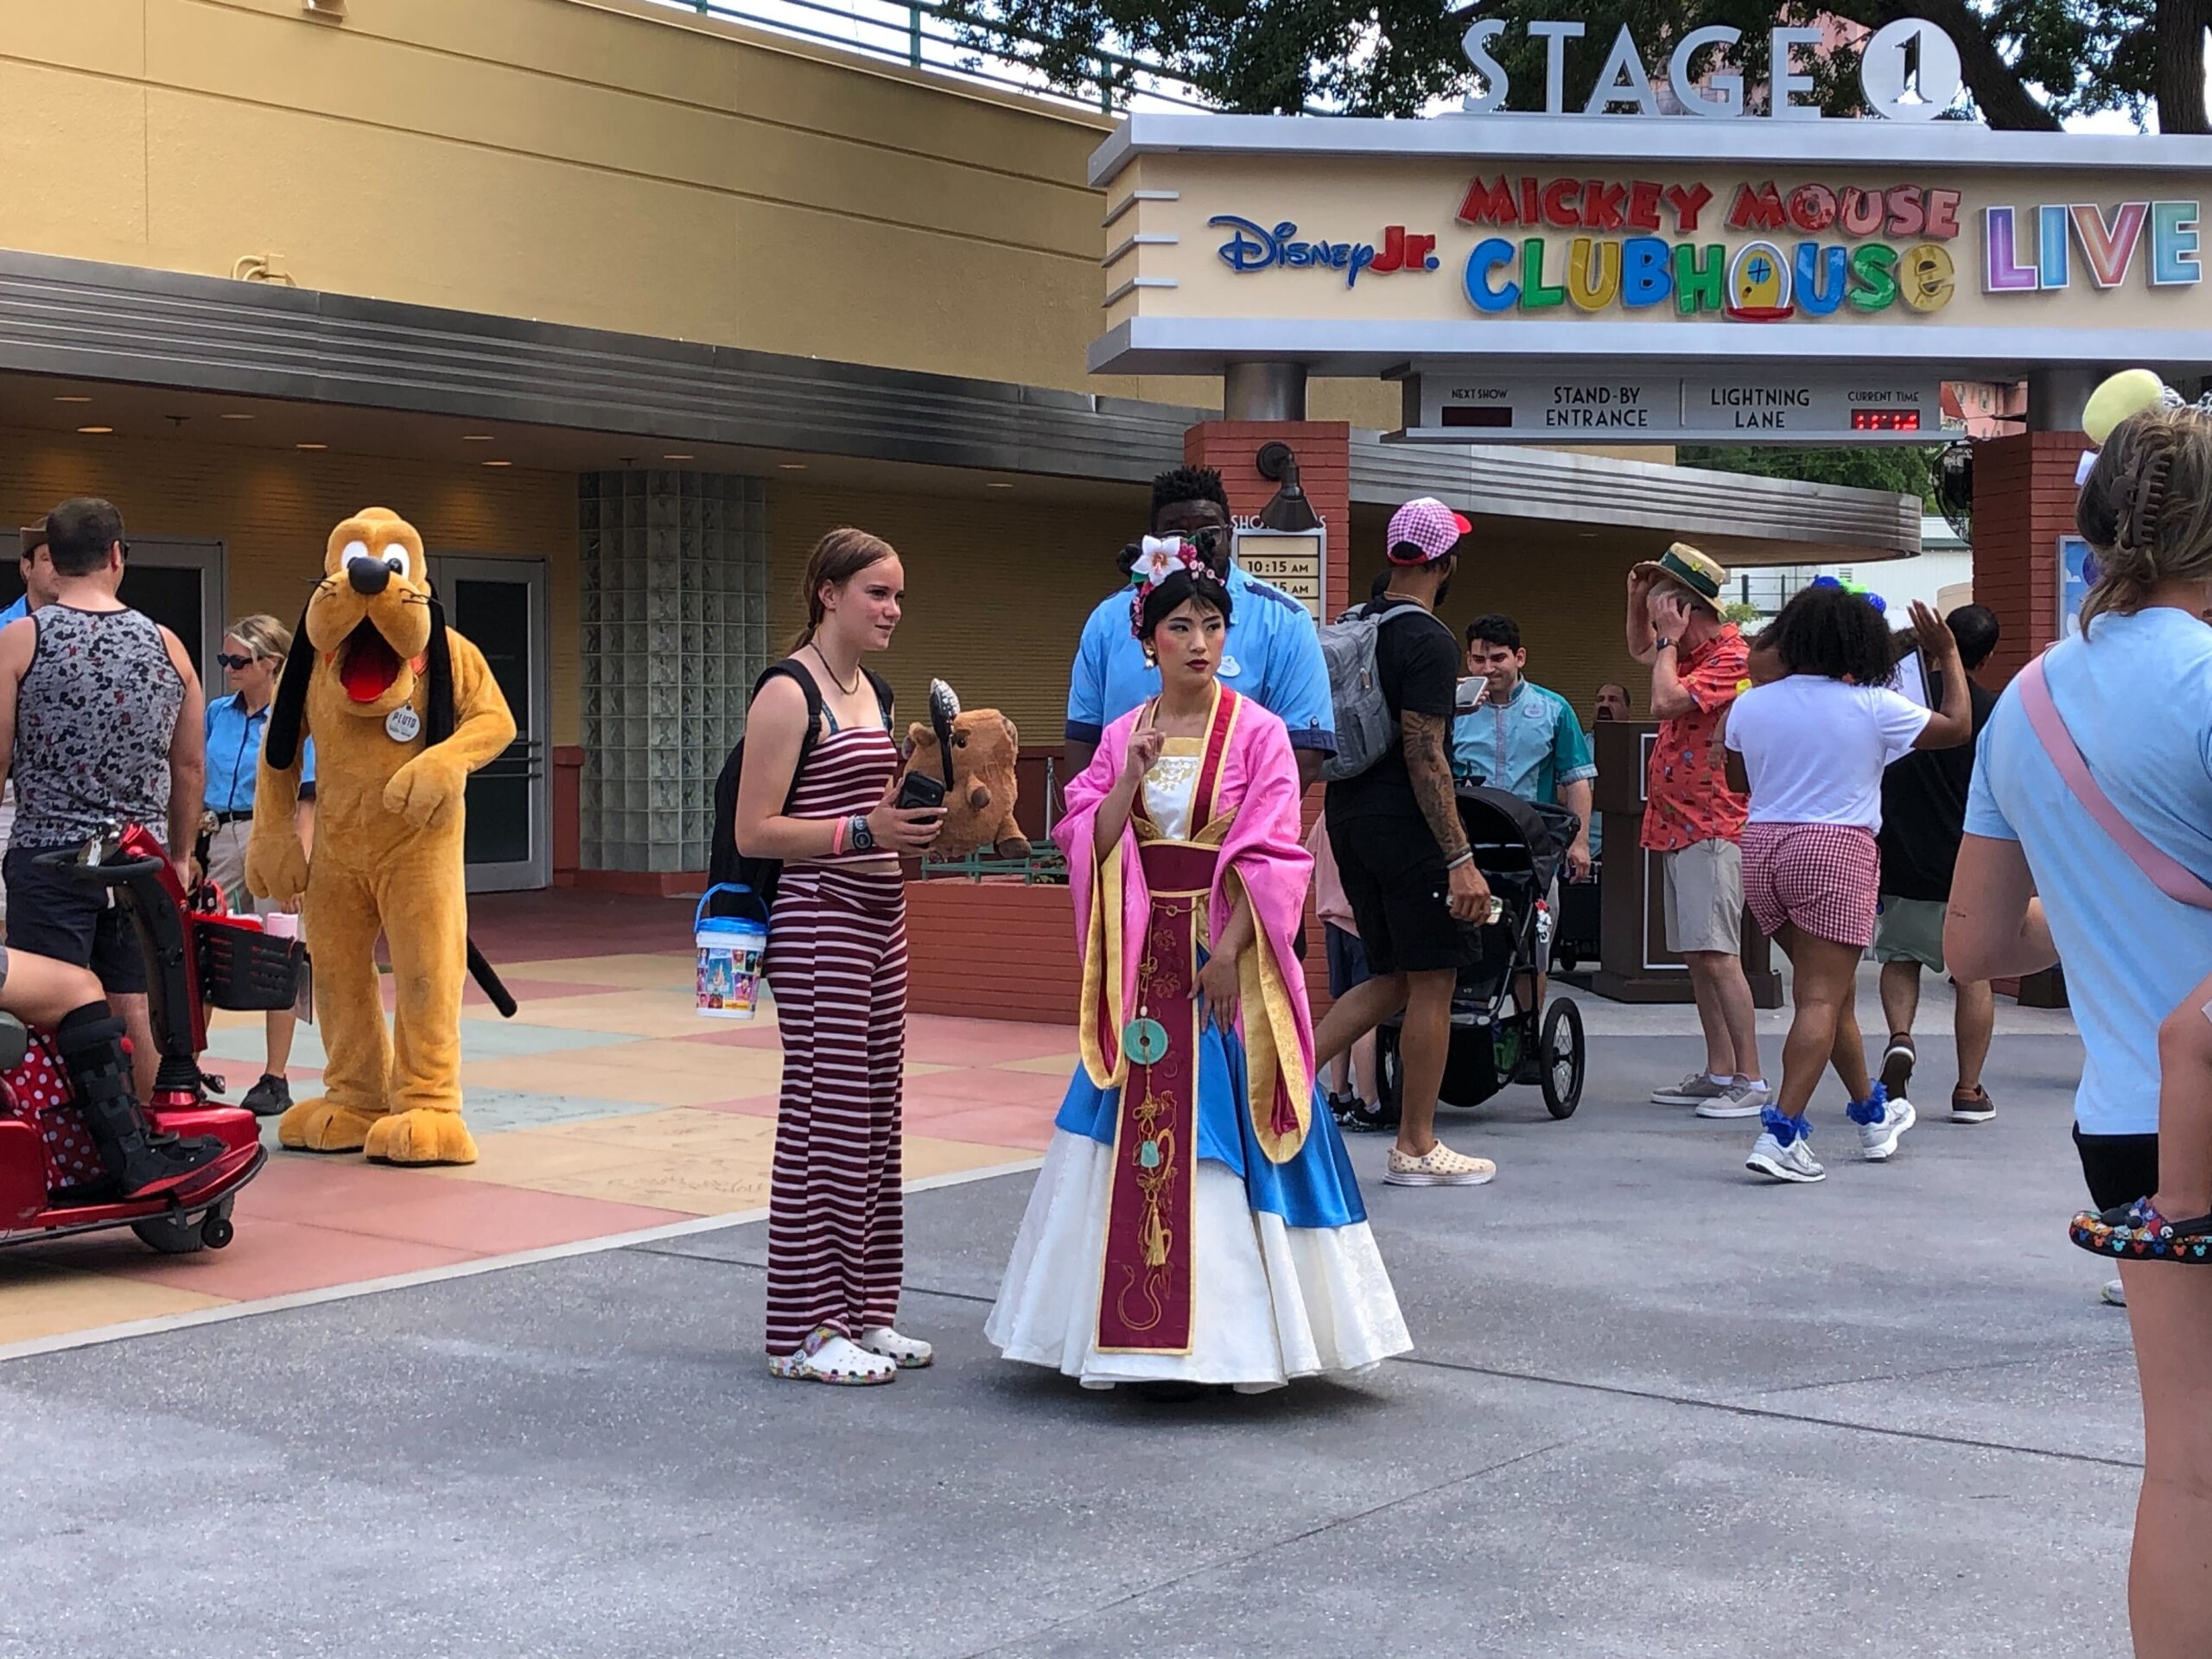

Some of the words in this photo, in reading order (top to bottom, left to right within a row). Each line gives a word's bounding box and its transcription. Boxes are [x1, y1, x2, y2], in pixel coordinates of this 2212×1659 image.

[1462, 18, 1823, 118] STAGE
[1890, 29, 1935, 104] 1
[1456, 175, 1713, 232] MICKEY
[1726, 180, 1962, 238] MOUSE
[1208, 214, 1374, 289] Disney
[1370, 225, 1440, 274] Jr.
[1983, 200, 2202, 293] LIVE
[1452, 389, 1476, 399] NEXT
[1478, 389, 1508, 399] SHOW
[1553, 386, 1641, 404] STAND-BY
[1711, 388, 1810, 407] LIGHTNING
[1847, 391, 1894, 402] CURRENT
[1896, 391, 1919, 402] TIME
[1545, 408, 1649, 428] ENTRANCE
[1734, 410, 1786, 429] LANE
[1248, 561, 1287, 573] 10:15
[1291, 564, 1308, 573] AM
[392, 711, 416, 728] PLUTO
